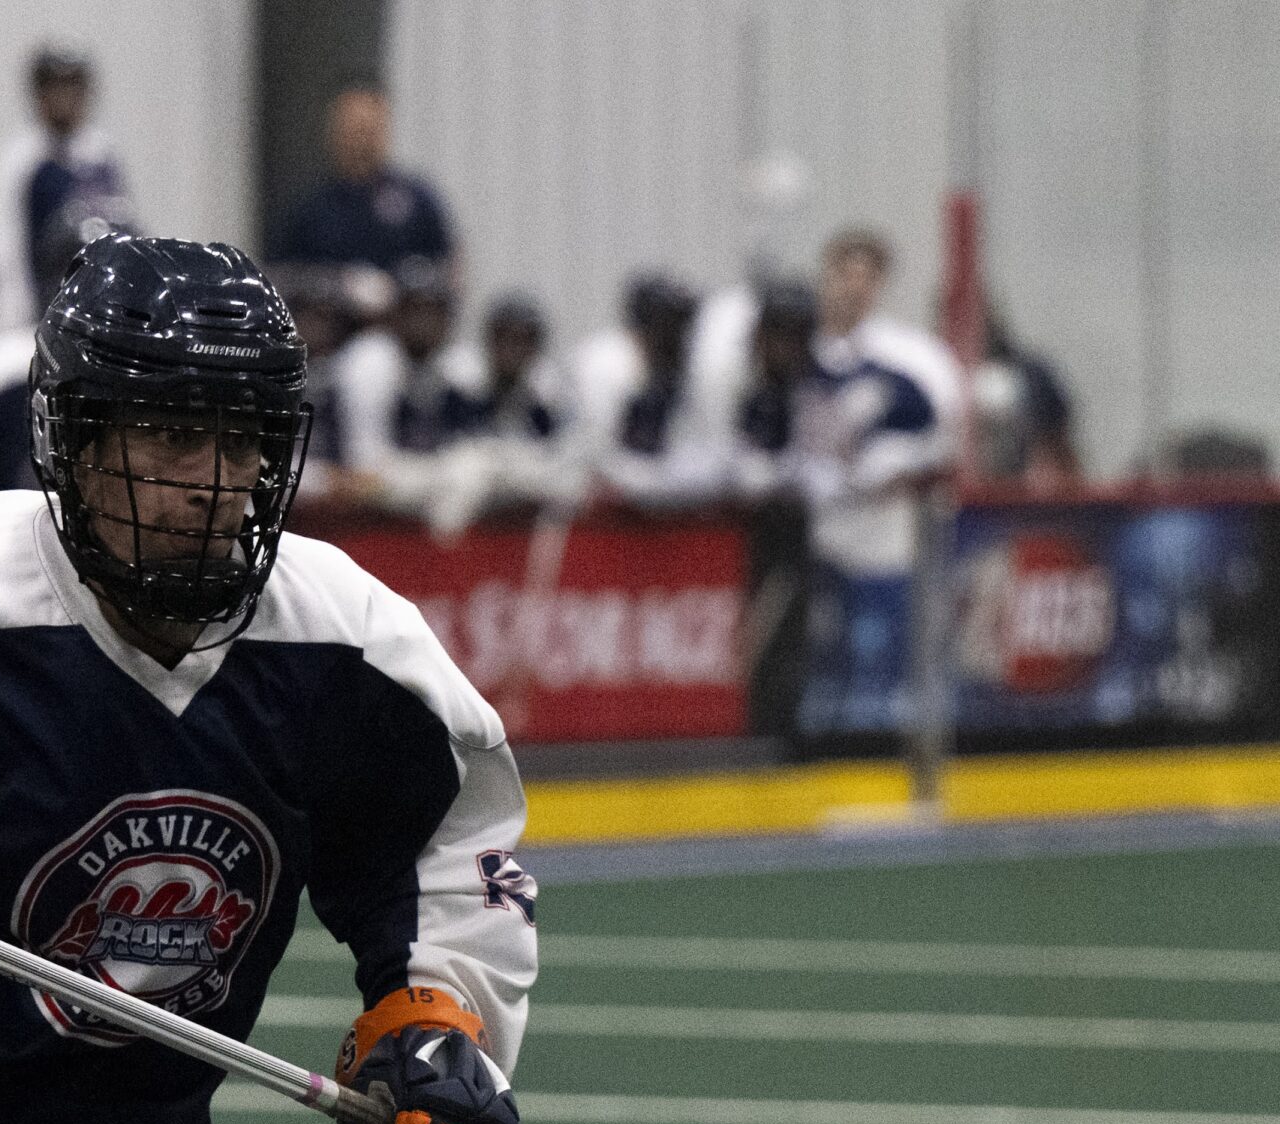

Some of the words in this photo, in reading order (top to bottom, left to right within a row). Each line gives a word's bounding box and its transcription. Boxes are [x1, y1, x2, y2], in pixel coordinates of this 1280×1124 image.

[78, 815, 250, 876] OAKVILLE
[86, 915, 217, 962] ROCK
[407, 987, 435, 1003] 15
